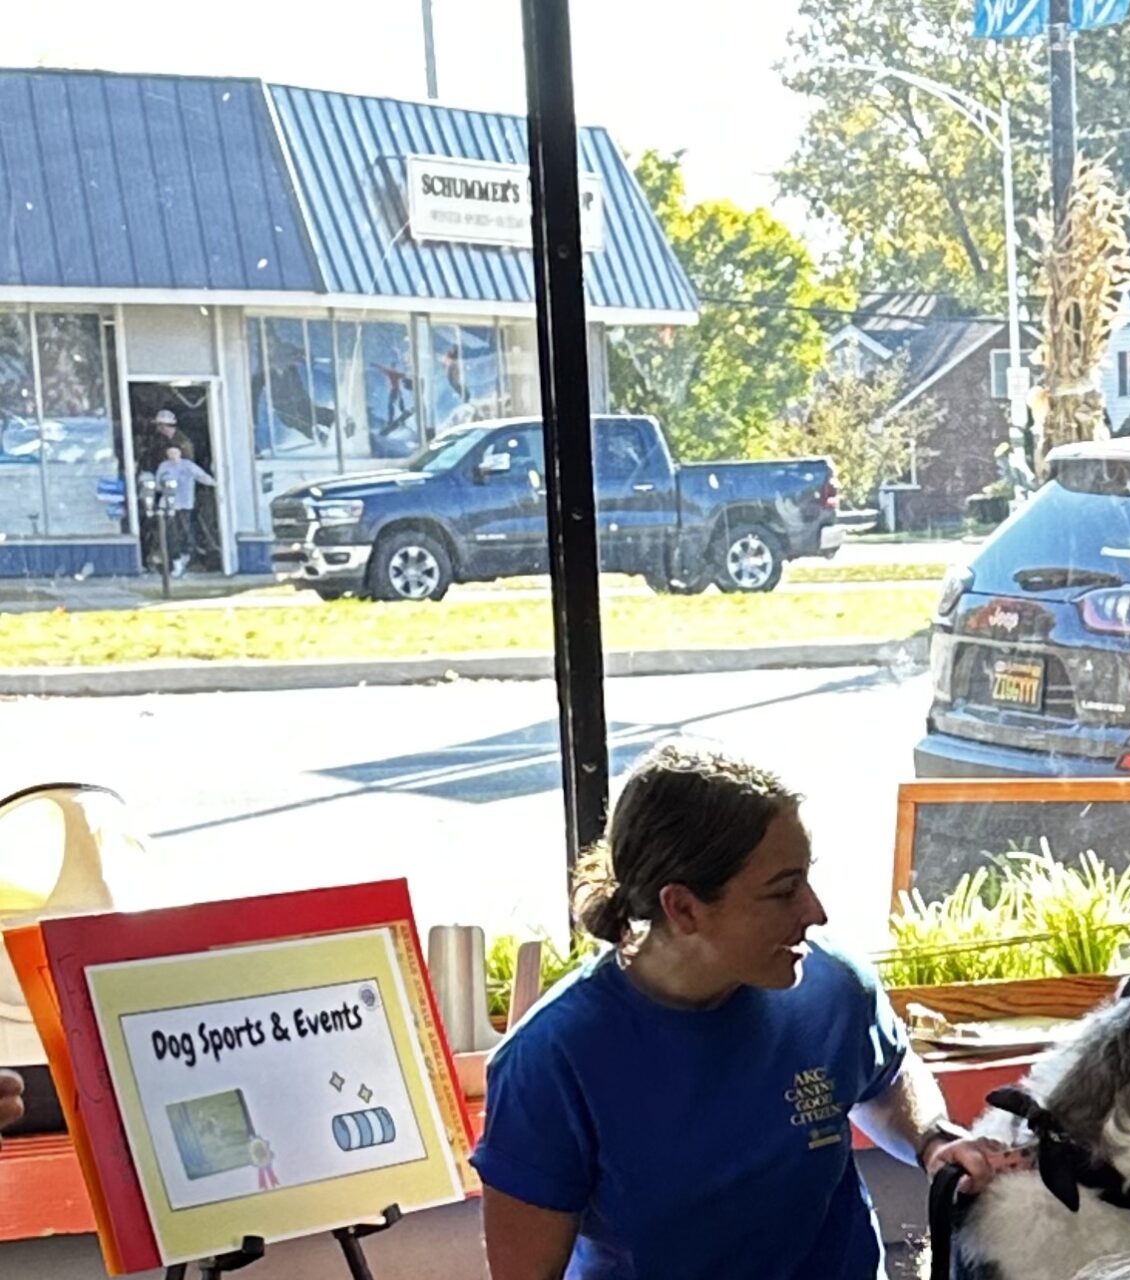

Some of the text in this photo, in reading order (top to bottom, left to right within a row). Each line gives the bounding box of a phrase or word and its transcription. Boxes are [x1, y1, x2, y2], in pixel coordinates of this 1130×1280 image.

[421, 173, 520, 204] SCHUMMER'S
[151, 1002, 363, 1067] Dog Sports & Events
[793, 1067, 827, 1087] AKC
